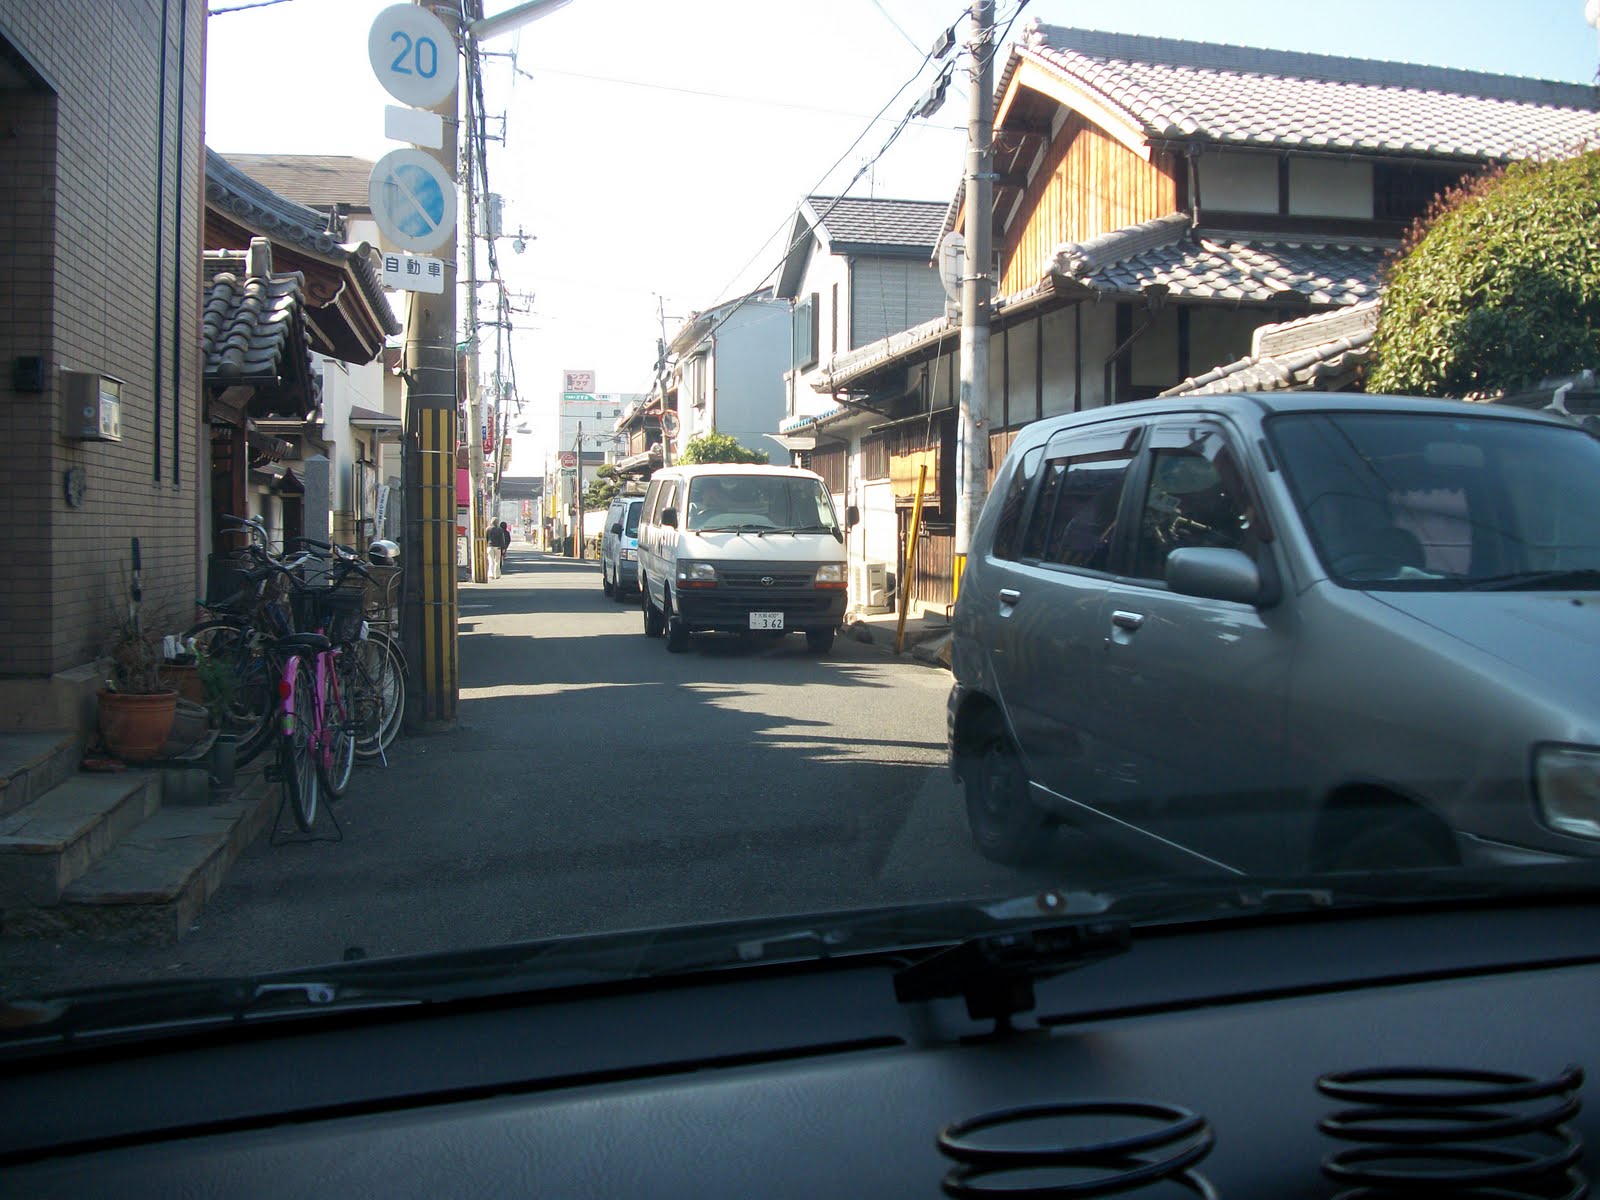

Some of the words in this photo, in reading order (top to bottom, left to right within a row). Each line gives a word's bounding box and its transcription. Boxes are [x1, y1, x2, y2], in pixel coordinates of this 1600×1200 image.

[390, 31, 438, 79] 20
[385, 256, 441, 278] 自動車
